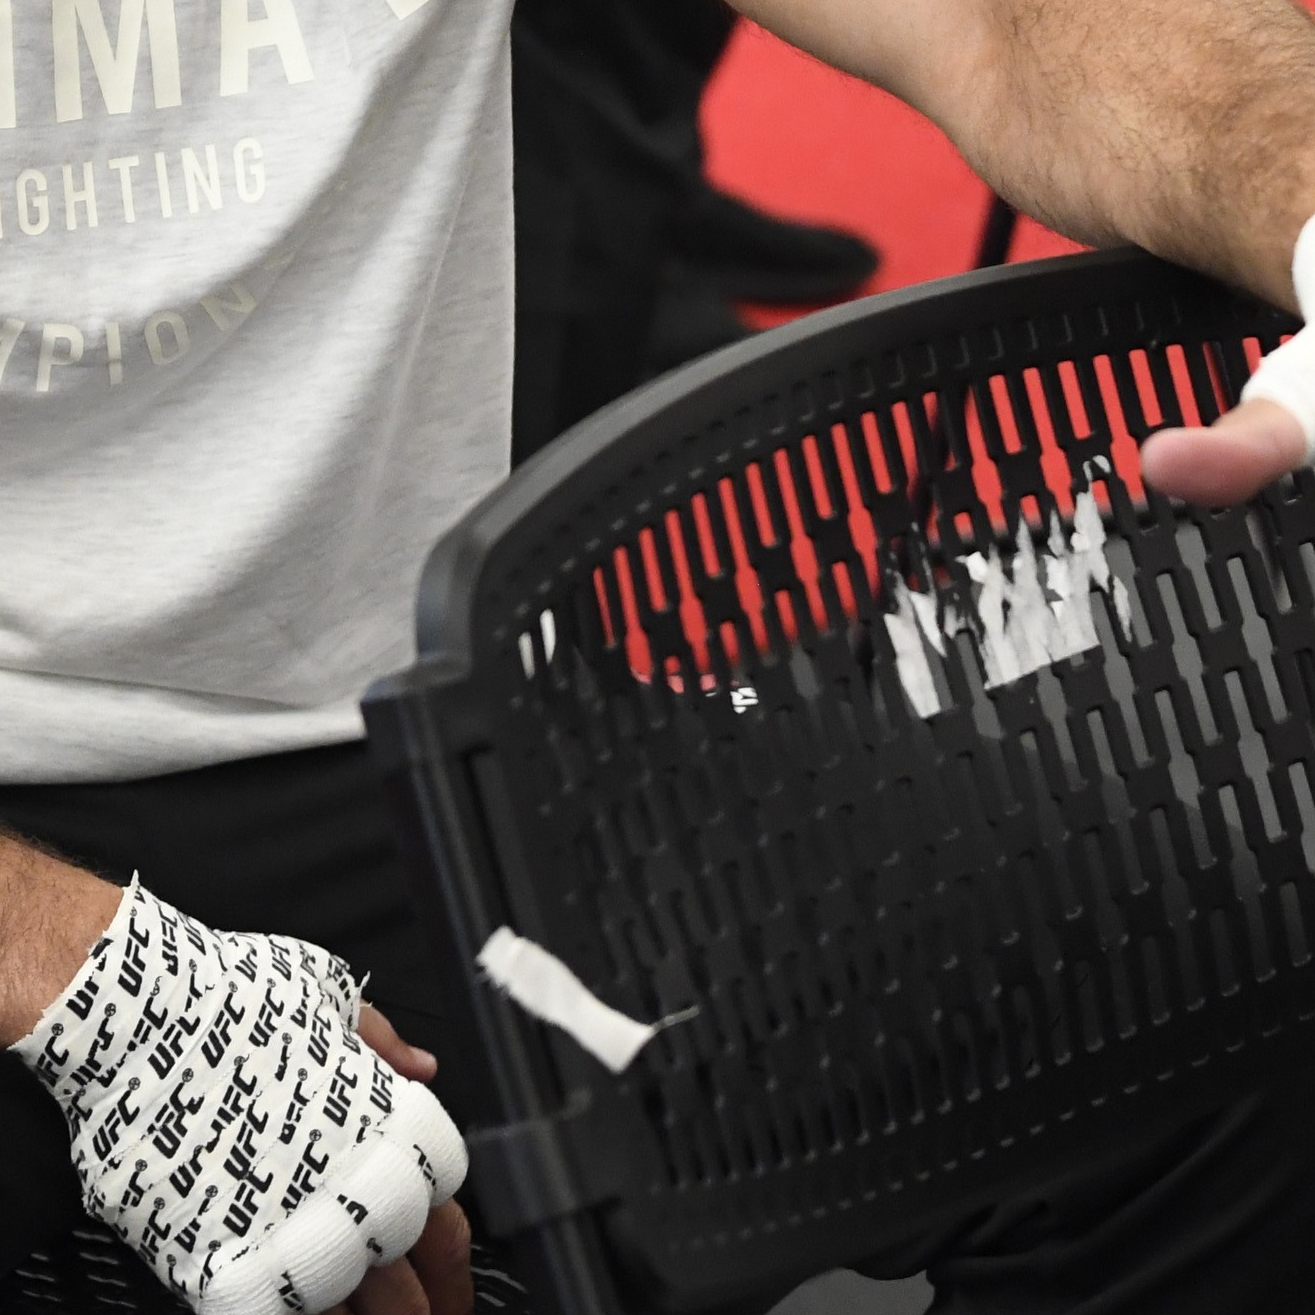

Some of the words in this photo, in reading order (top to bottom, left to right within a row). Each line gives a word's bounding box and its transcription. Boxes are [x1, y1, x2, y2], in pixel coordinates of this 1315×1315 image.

[118, 917, 150, 997] UFC
[268, 938, 292, 982] UFC
[147, 1016, 201, 1080] UFC
[201, 992, 245, 1068] UFC
[249, 987, 285, 1047] UFC
[307, 1006, 332, 1068] UFC
[323, 1062, 358, 1127] UFC
[370, 1058, 394, 1114] UFC
[93, 1090, 140, 1161] UFC
[223, 1100, 269, 1180] UFC
[222, 1172, 274, 1237] UFC
[280, 1142, 330, 1211] UFC
